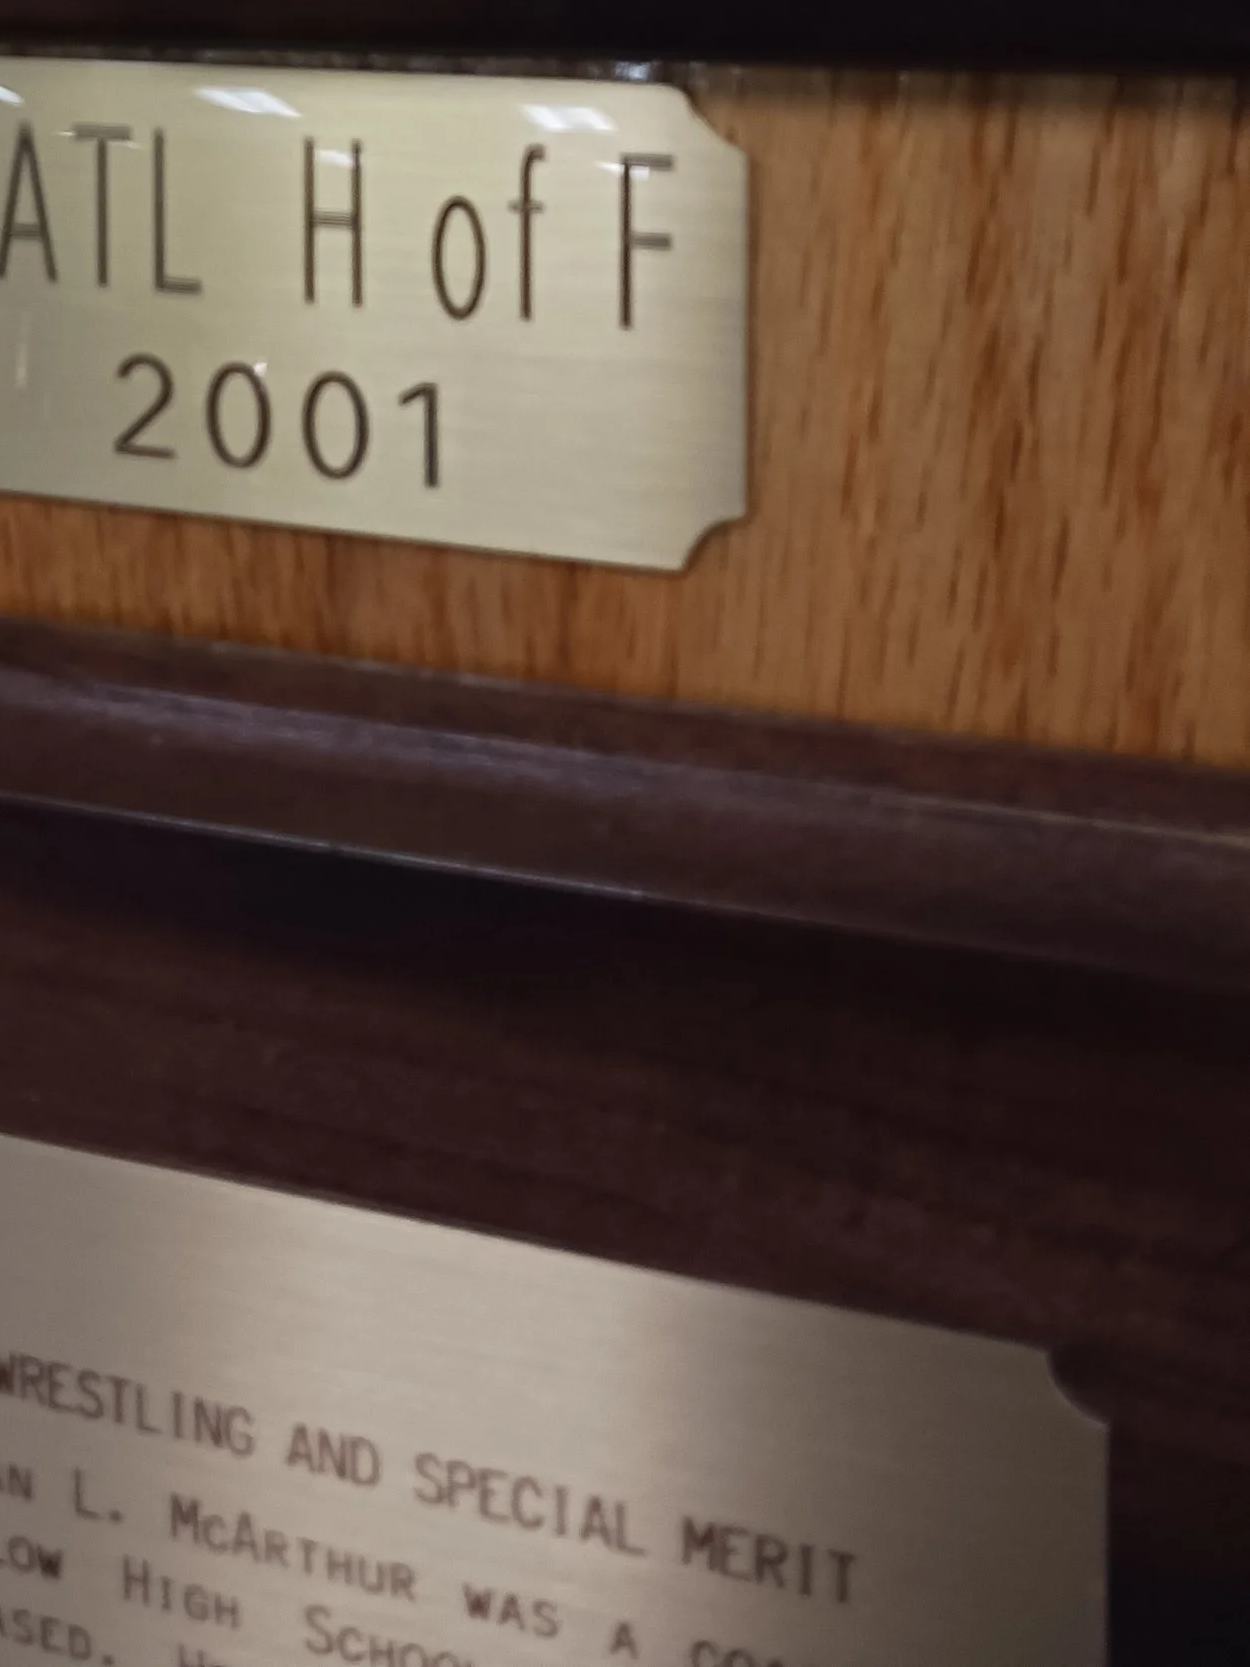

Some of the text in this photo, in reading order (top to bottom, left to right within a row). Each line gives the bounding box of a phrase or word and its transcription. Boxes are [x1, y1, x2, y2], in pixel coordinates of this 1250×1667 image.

[302, 135, 365, 311] H
[432, 141, 547, 324] of
[622, 150, 675, 330] F
[114, 352, 445, 491] 2001
[73, 1467, 124, 1525] L.
[463, 1582, 561, 1639] WAS
[611, 1621, 638, 1660] A
[121, 1555, 242, 1630] HIGH
[285, 1422, 382, 1488] AND
[414, 1452, 647, 1558] SPECIAL
[681, 1515, 858, 1605] MERIT
